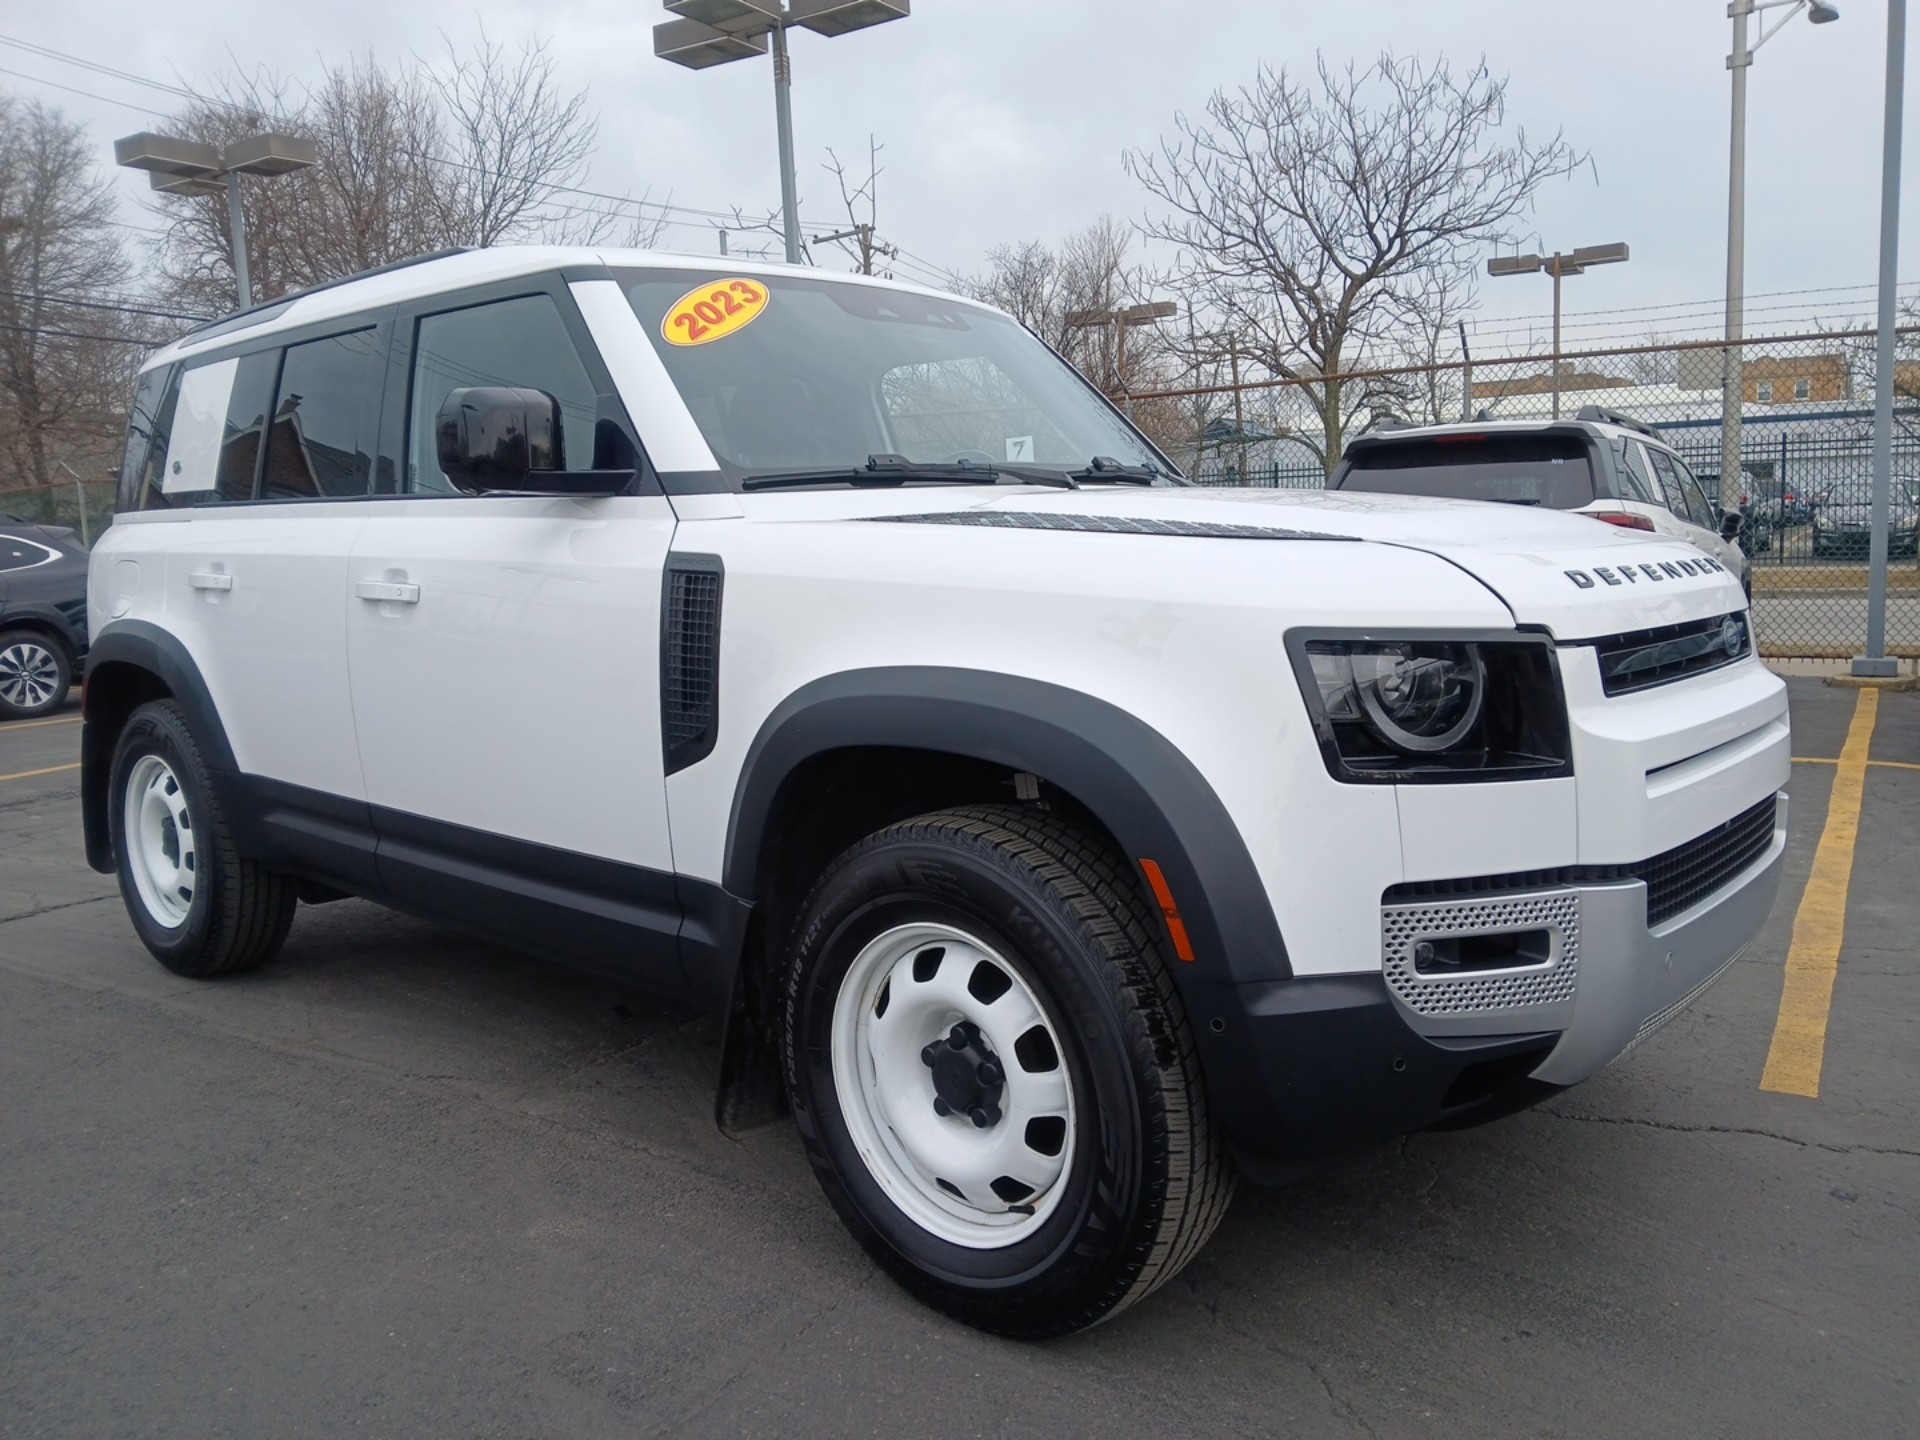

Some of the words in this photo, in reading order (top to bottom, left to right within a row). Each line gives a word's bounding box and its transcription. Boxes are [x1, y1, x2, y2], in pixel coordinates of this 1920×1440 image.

[674, 281, 762, 341] 2023
[1012, 440, 1026, 461] 7
[1563, 557, 1725, 589] DEFENDER
[789, 957, 804, 998] R18
[800, 915, 823, 956] 112T
